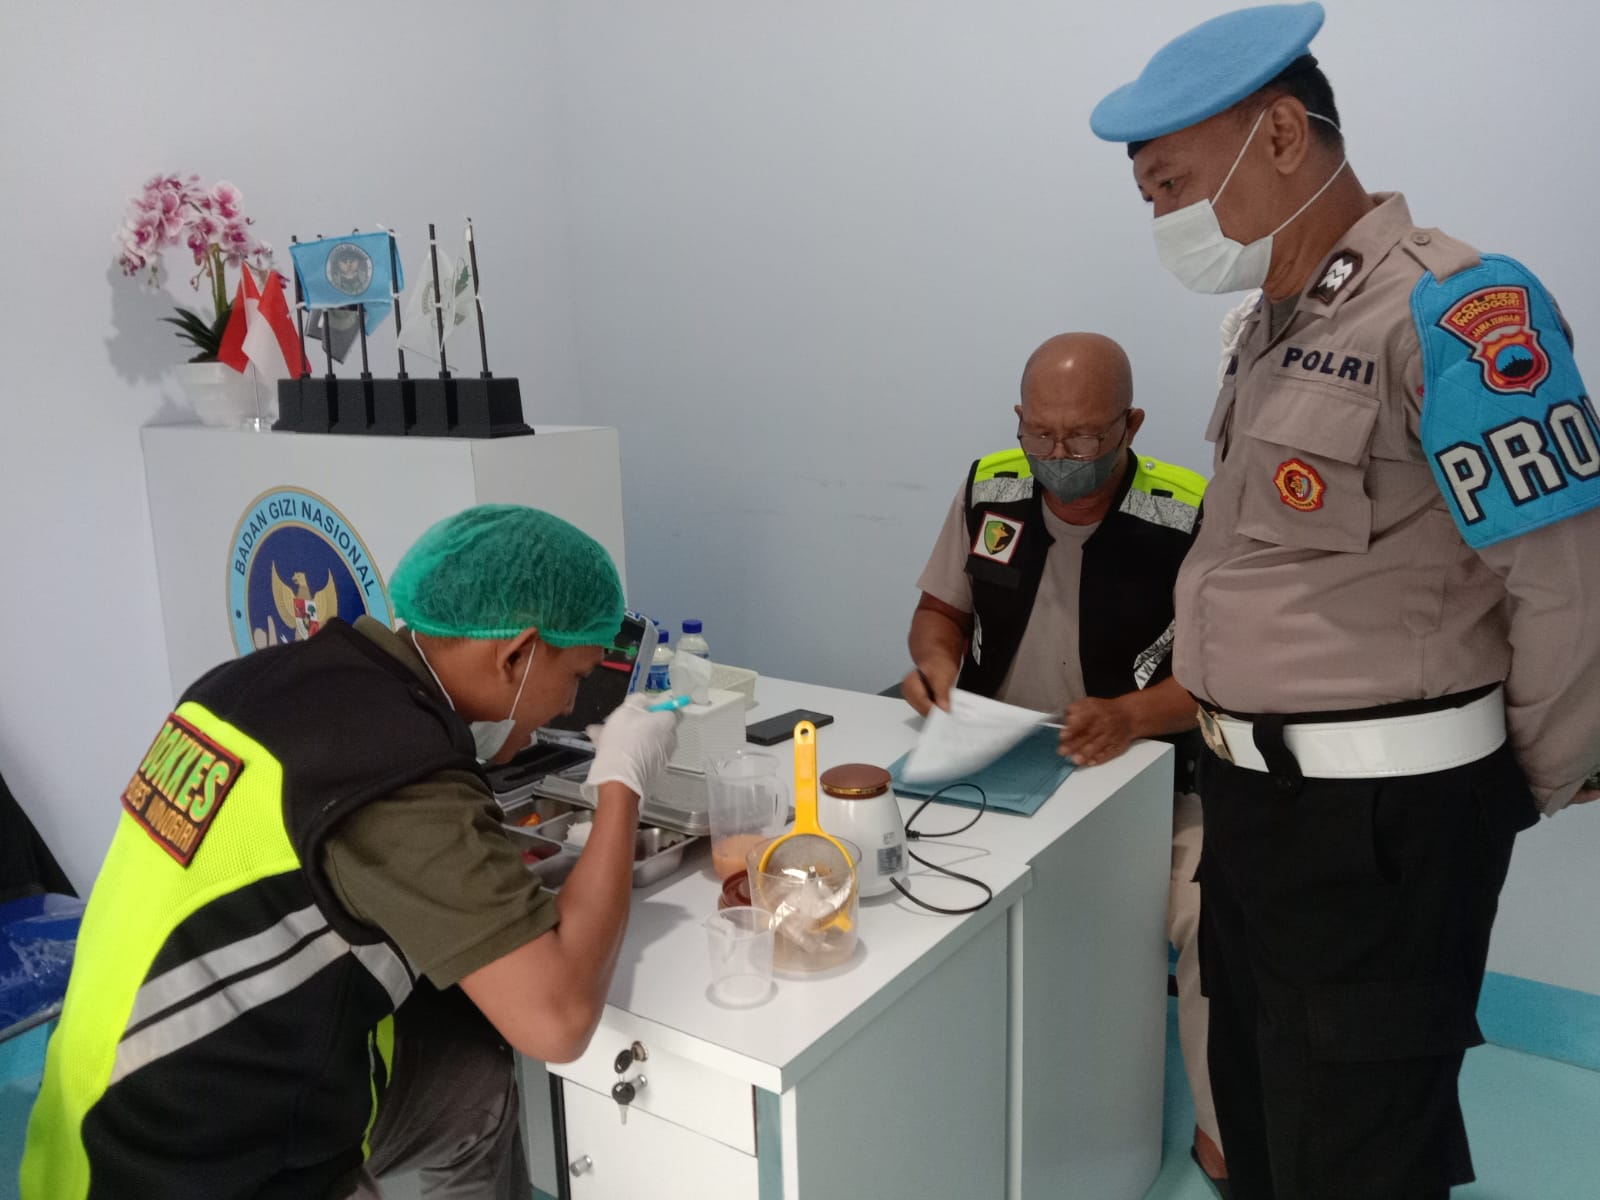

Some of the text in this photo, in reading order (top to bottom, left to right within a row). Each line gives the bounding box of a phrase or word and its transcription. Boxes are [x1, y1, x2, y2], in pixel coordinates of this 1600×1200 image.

[1281, 347, 1375, 385] POLRI
[1434, 396, 1600, 526] PRO
[235, 499, 375, 597] BADAN GIZI NASIONAL
